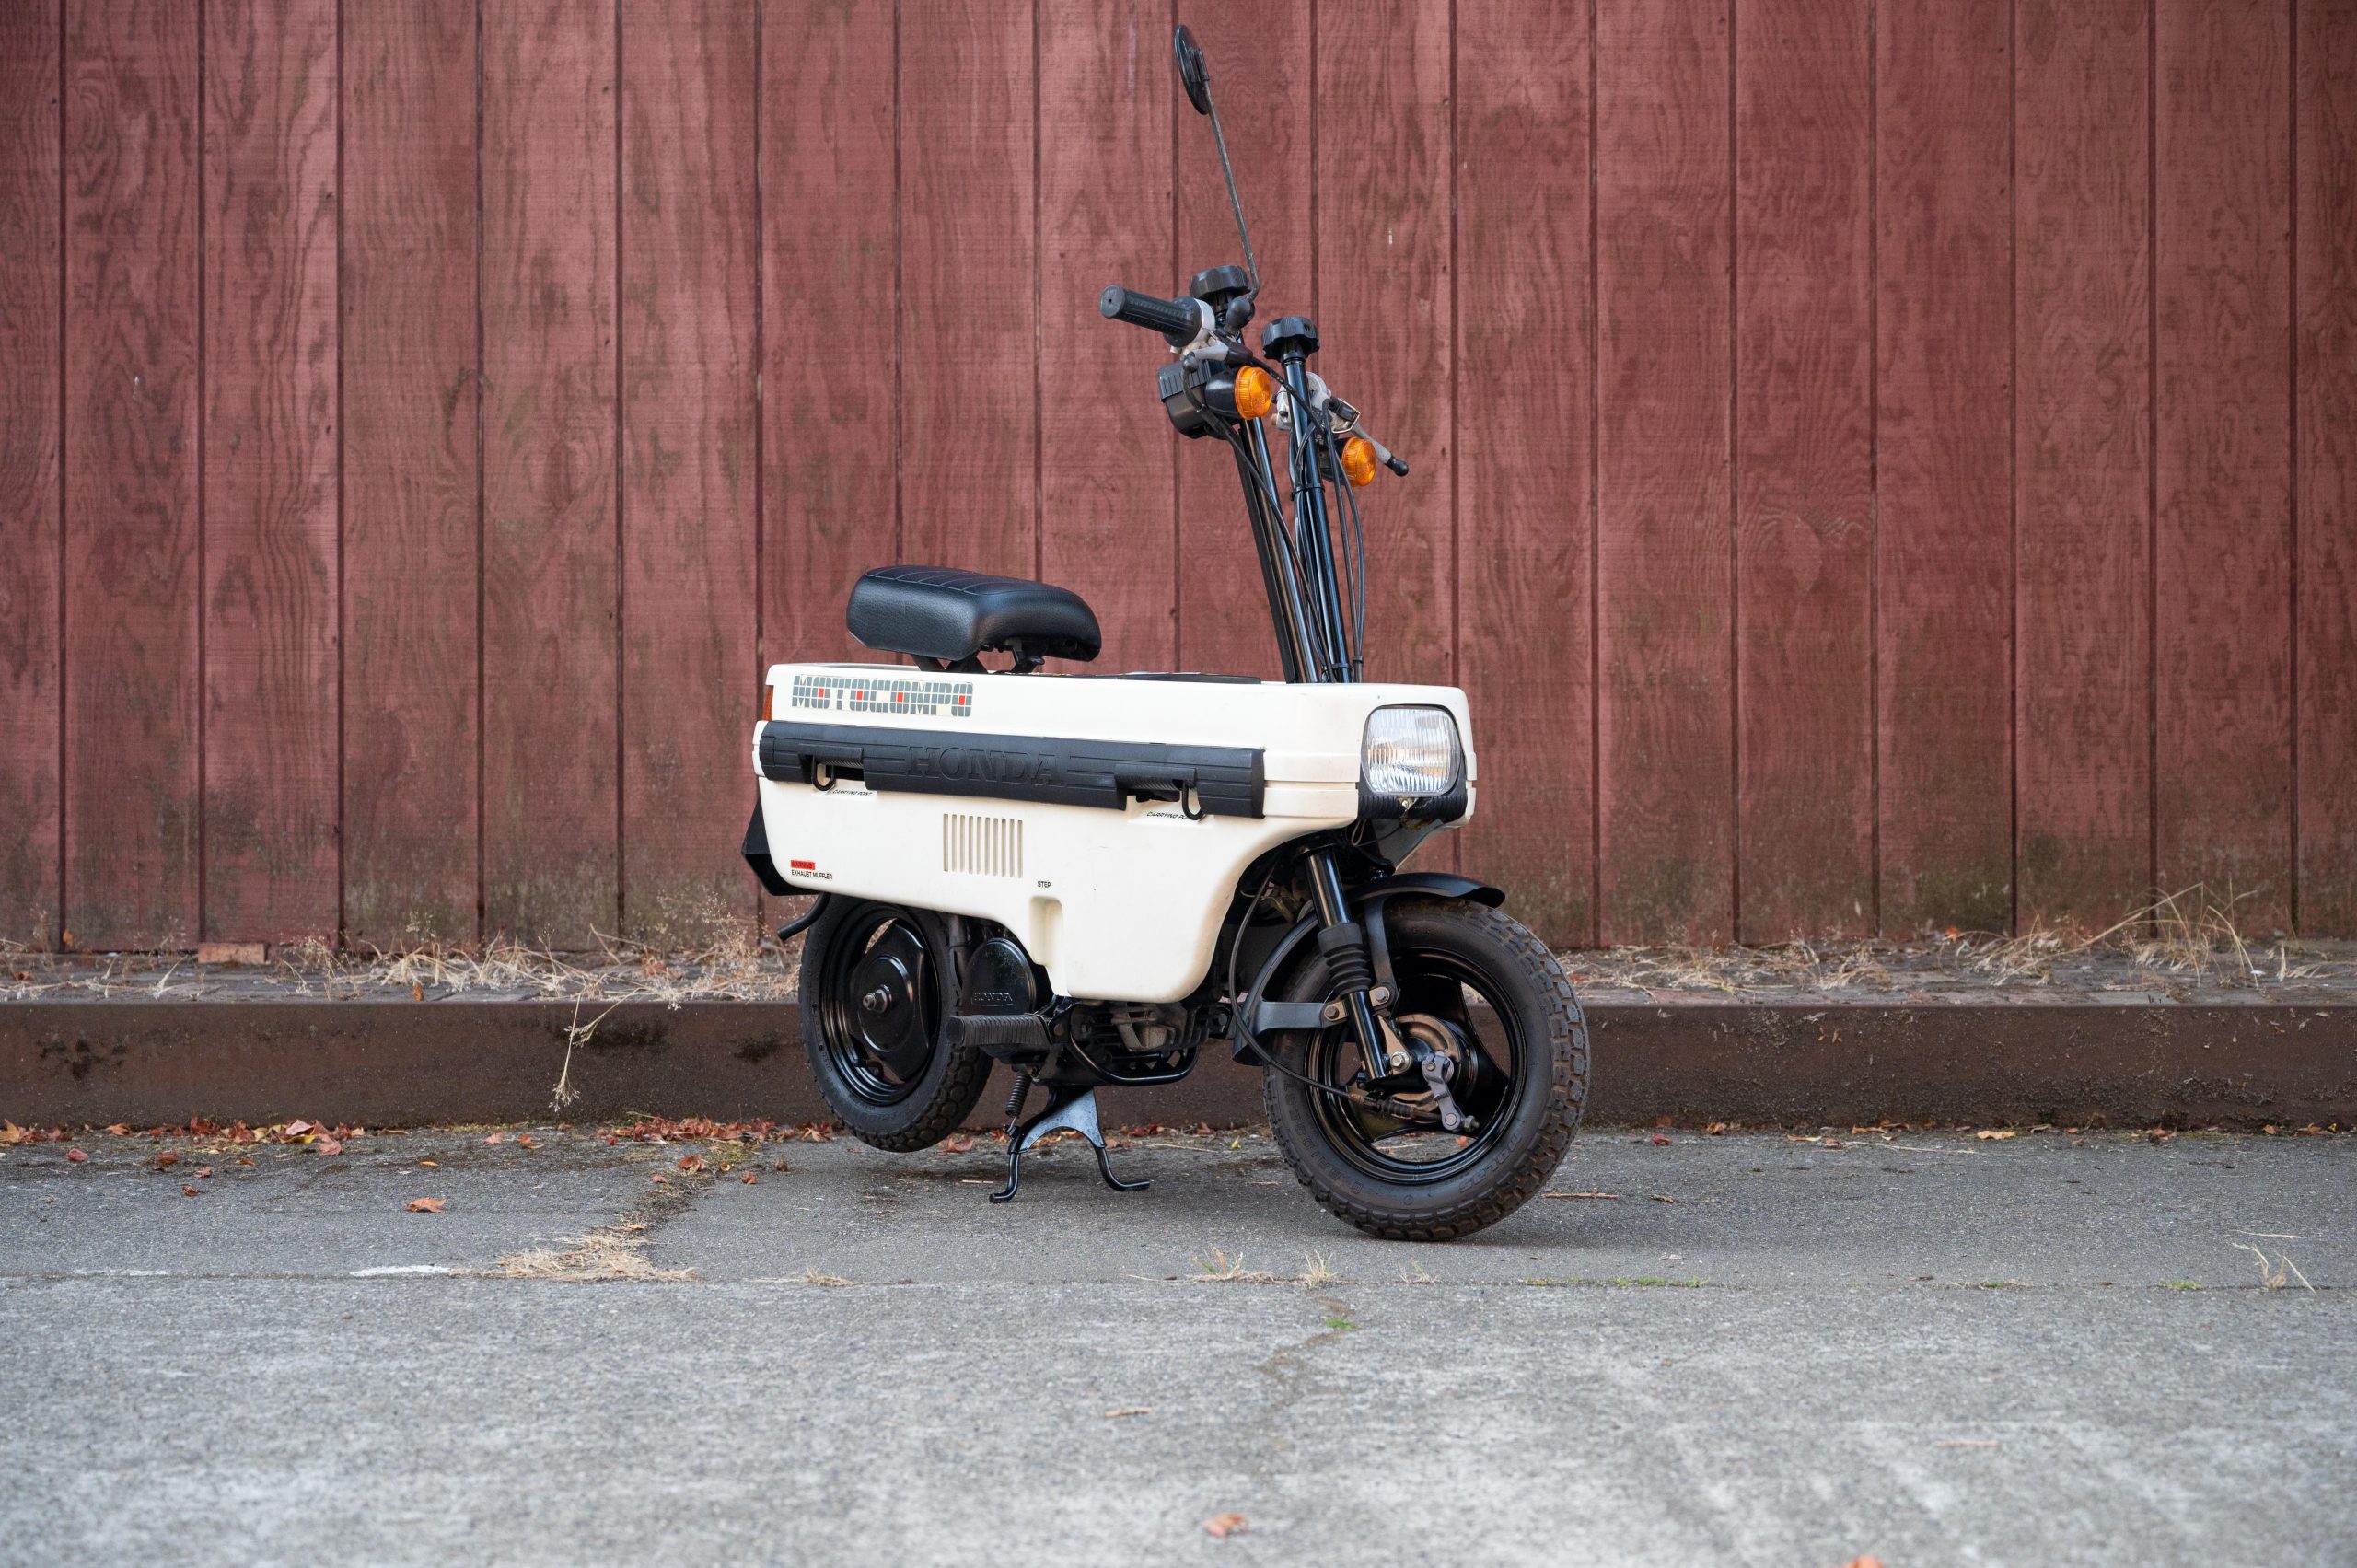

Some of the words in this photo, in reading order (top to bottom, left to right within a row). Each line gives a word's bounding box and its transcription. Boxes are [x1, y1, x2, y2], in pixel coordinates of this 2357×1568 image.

[792, 675, 973, 717] MOTOCOMPO
[907, 746, 1065, 788] HONDA
[792, 869, 812, 877] EXHAUST
